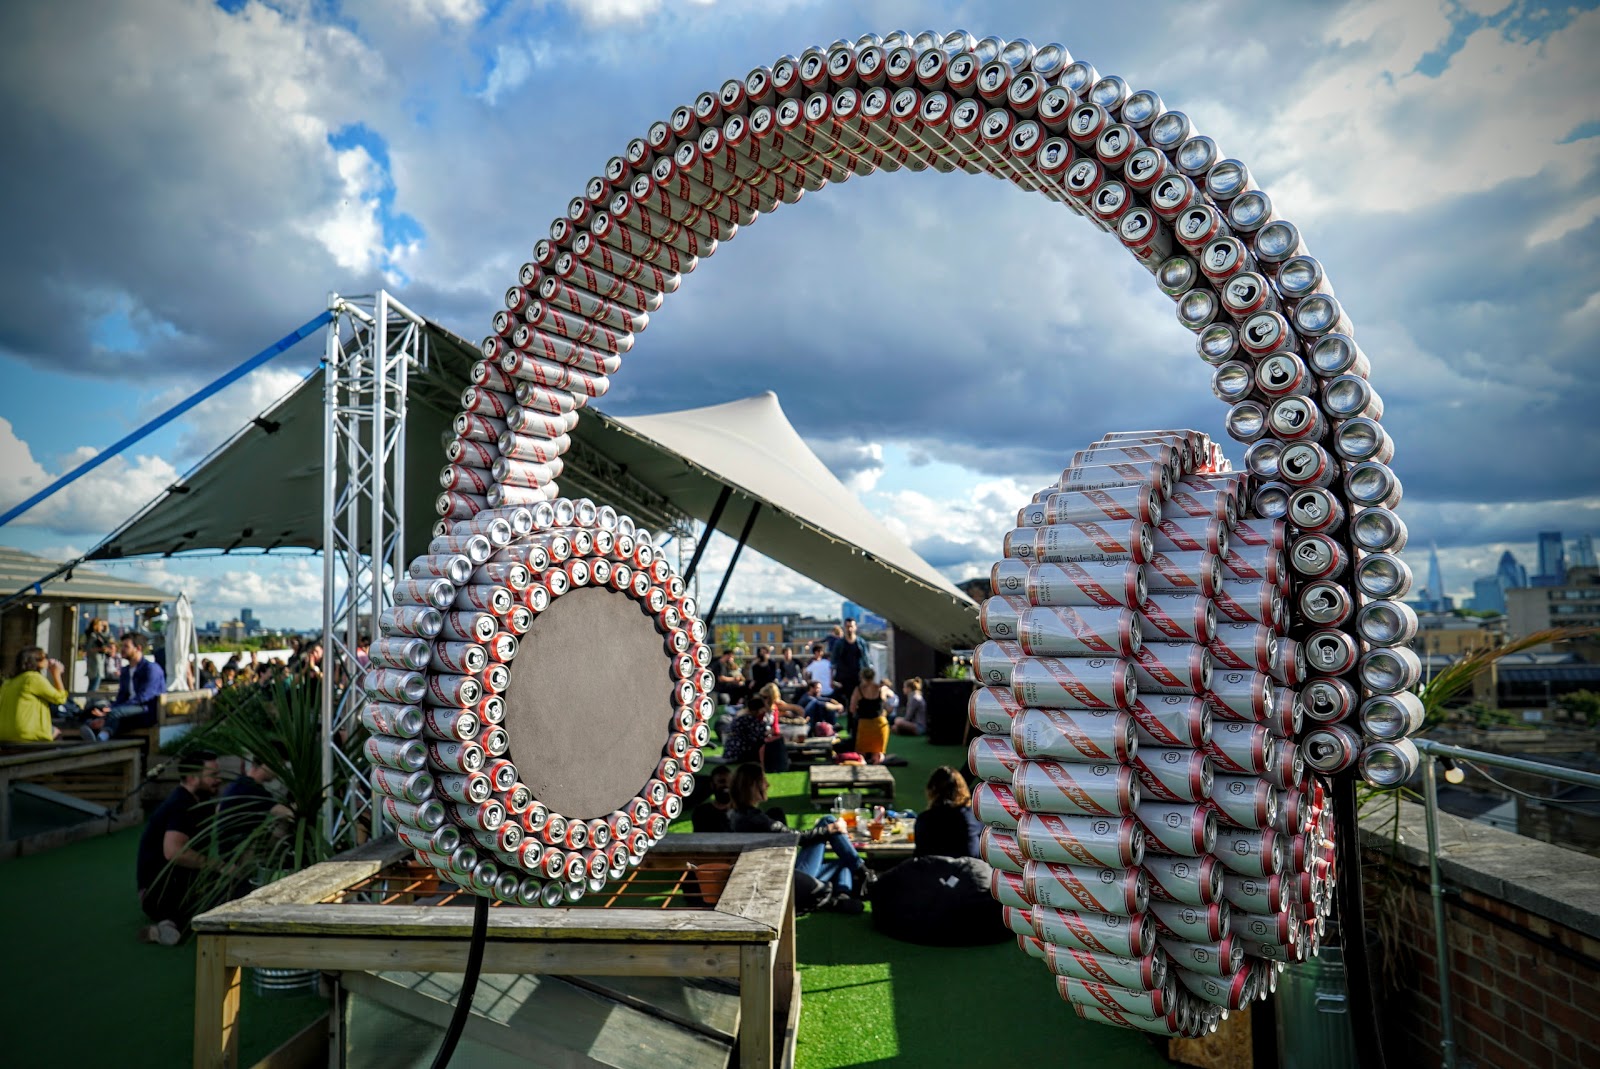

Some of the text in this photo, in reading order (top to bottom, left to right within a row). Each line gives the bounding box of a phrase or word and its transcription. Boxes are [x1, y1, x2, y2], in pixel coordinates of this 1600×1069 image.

[1143, 603, 1177, 634] Stripe
[1138, 651, 1172, 682] Stripe
[1202, 692, 1236, 718] Stripe
[1136, 711, 1172, 742] Stripe
[1045, 764, 1069, 784] Red
[997, 786, 1021, 816] Stripe
[1053, 865, 1079, 888] Red
